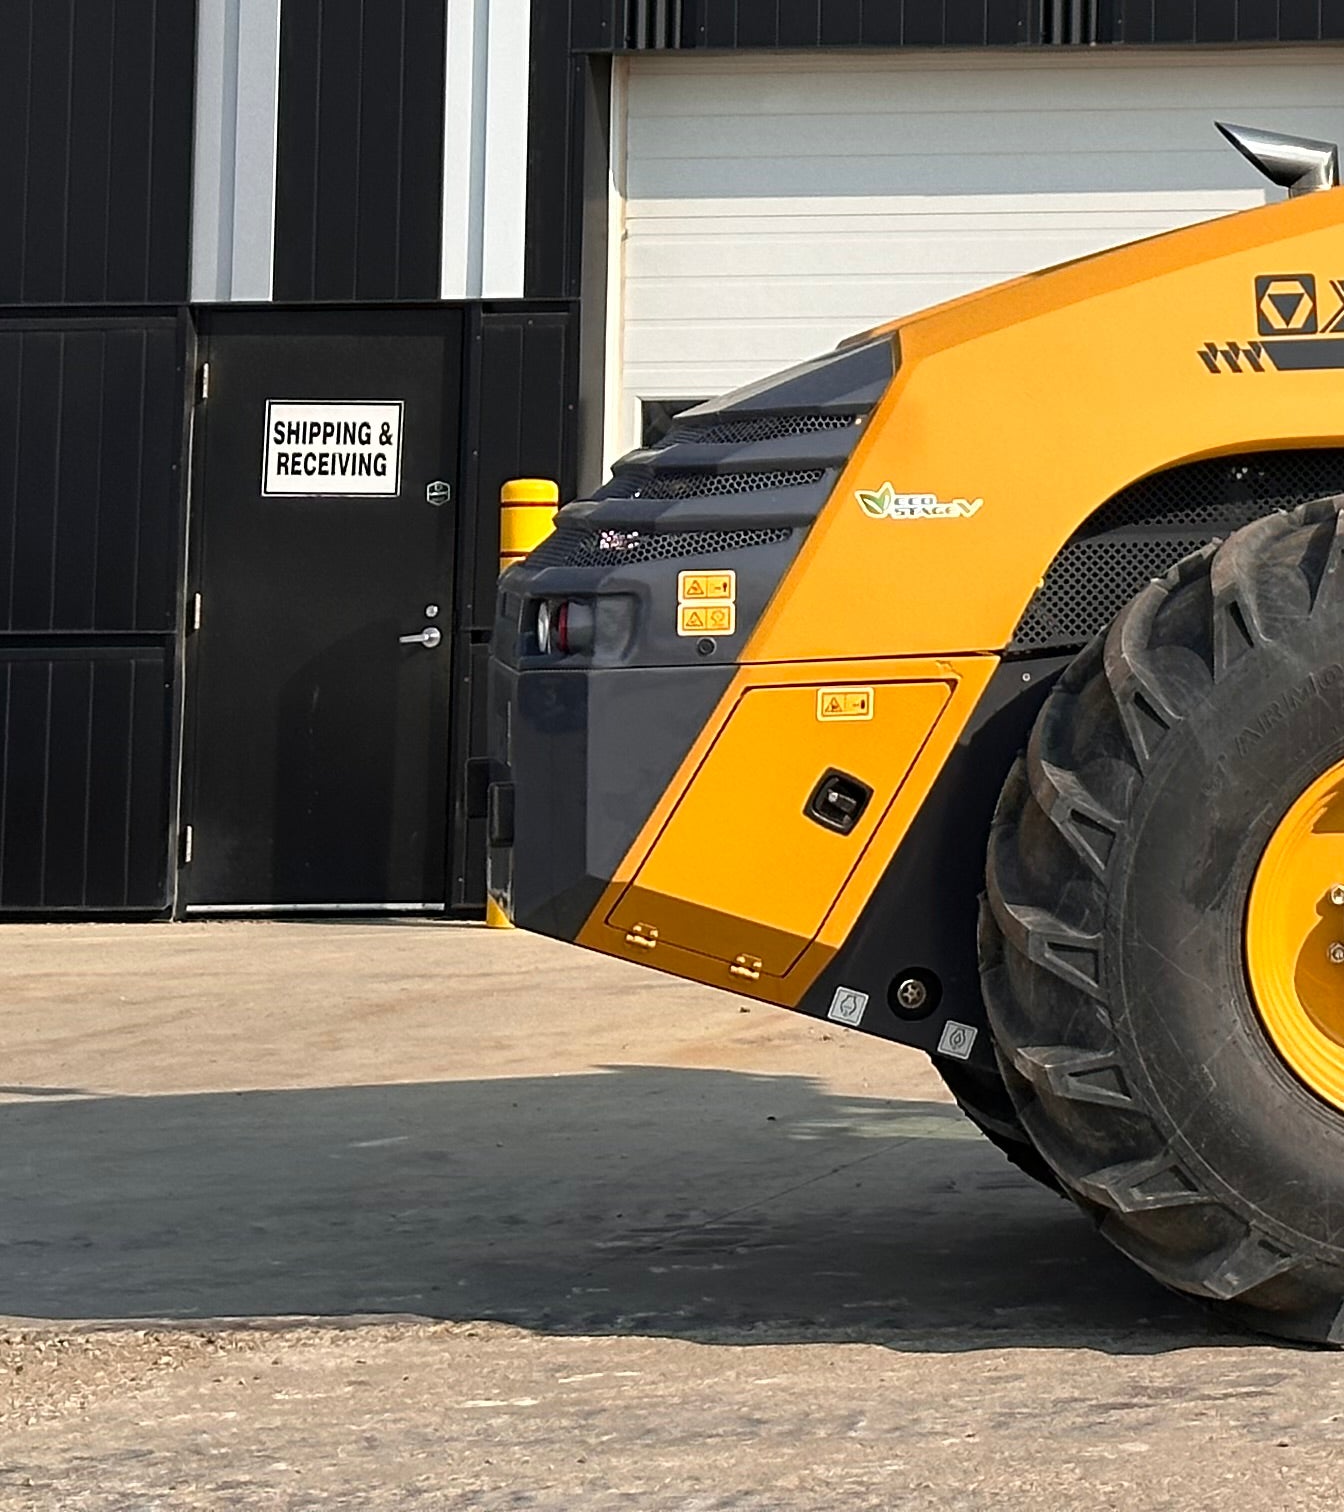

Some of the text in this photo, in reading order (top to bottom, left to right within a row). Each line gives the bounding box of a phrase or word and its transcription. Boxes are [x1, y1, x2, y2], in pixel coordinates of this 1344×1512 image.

[273, 420, 394, 446] SHIPPING &
[276, 452, 388, 477] RECEIVING
